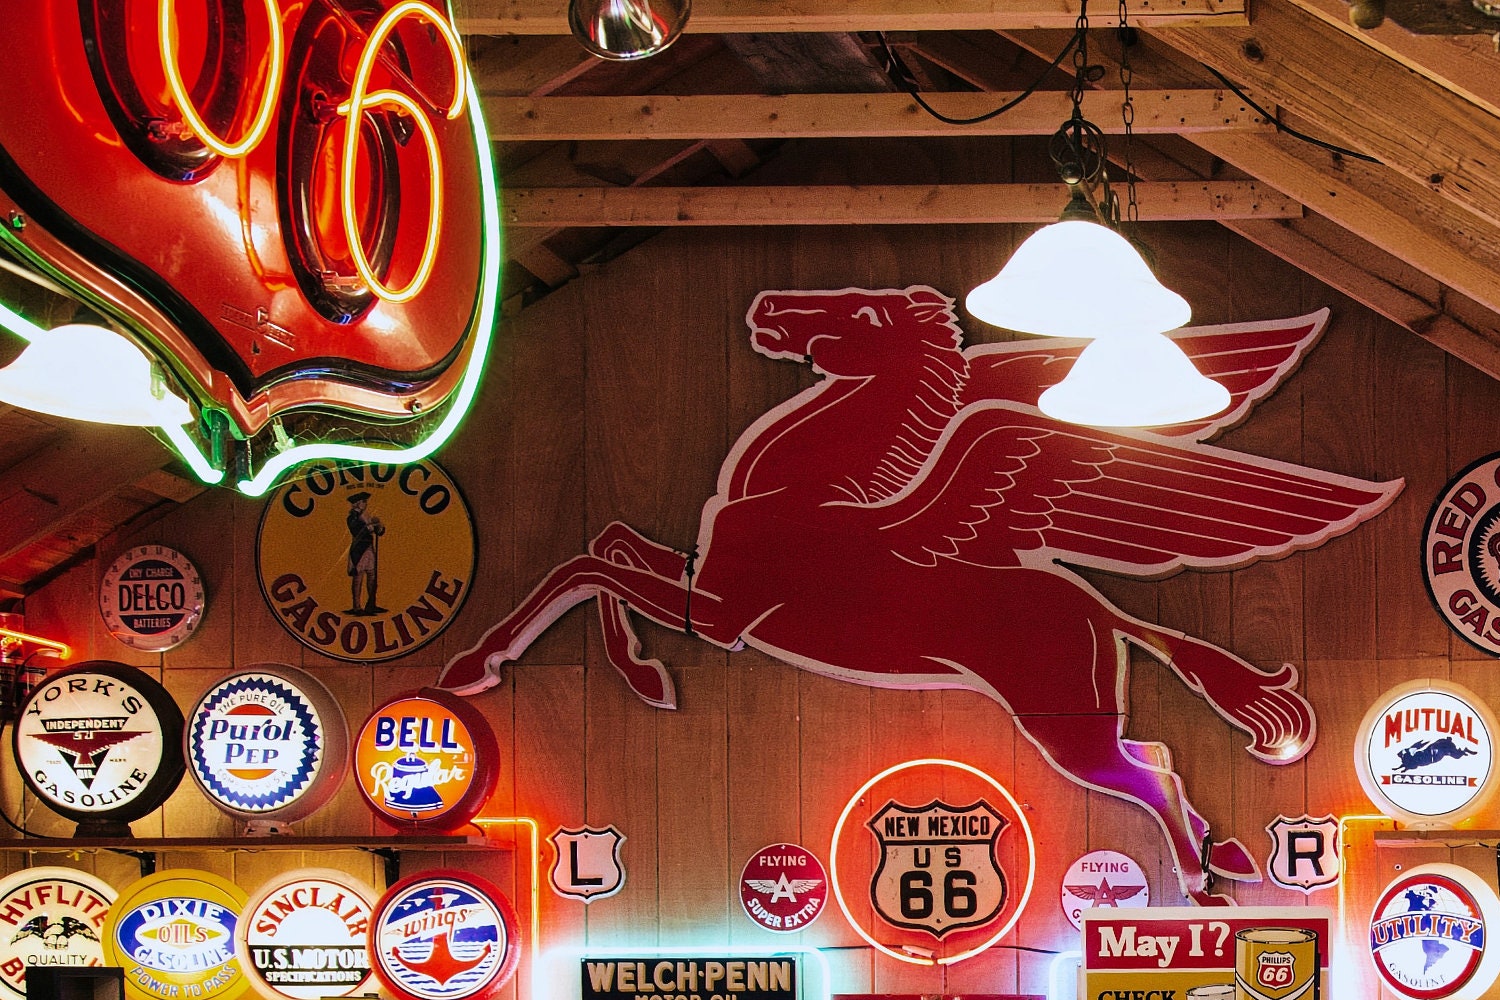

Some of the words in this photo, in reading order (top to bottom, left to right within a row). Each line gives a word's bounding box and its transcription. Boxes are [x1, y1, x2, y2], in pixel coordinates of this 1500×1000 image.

[1432, 482, 1488, 577] RED
[118, 582, 186, 611] DELCO
[133, 616, 172, 630] BATTERIES
[272, 569, 464, 655] GASOLINE
[26, 678, 143, 716] YORK'S
[45, 718, 125, 731] INDEPENDENT
[374, 716, 462, 753] BELL
[1385, 708, 1479, 748] MUTUAL
[225, 743, 279, 764] PEP
[35, 767, 147, 808] GASOLINE
[370, 758, 466, 802] Regular
[1393, 775, 1467, 785] GASOLINE
[885, 817, 920, 837] NEW
[928, 815, 990, 837] MEXICO
[570, 840, 603, 886] L
[759, 855, 807, 867] FLYING
[913, 848, 931, 868] U
[945, 847, 961, 868] S
[1081, 861, 1129, 873] FLYING
[1288, 831, 1324, 877] R
[0, 885, 109, 927] HYFLITE
[899, 869, 978, 919] 66
[141, 899, 223, 923] DIXIE
[256, 887, 370, 937] SINCLAIR
[403, 908, 468, 941] wings
[747, 897, 781, 928] SUPER
[785, 897, 821, 928] EXTRA
[157, 924, 208, 943] OILS
[1373, 914, 1481, 944] UTILITY
[134, 945, 235, 970] GASOLINE
[293, 948, 370, 969] MOTOR
[1097, 925, 1180, 967] May
[1187, 921, 1231, 957] I?
[27, 954, 88, 967] QUALITY
[1261, 956, 1291, 965] PHILLIPS
[1264, 967, 1289, 982] 66
[130, 965, 178, 997] POWER
[183, 983, 201, 998] TO
[204, 964, 238, 993] PASS
[265, 970, 362, 983] SPECIFICATIONS
